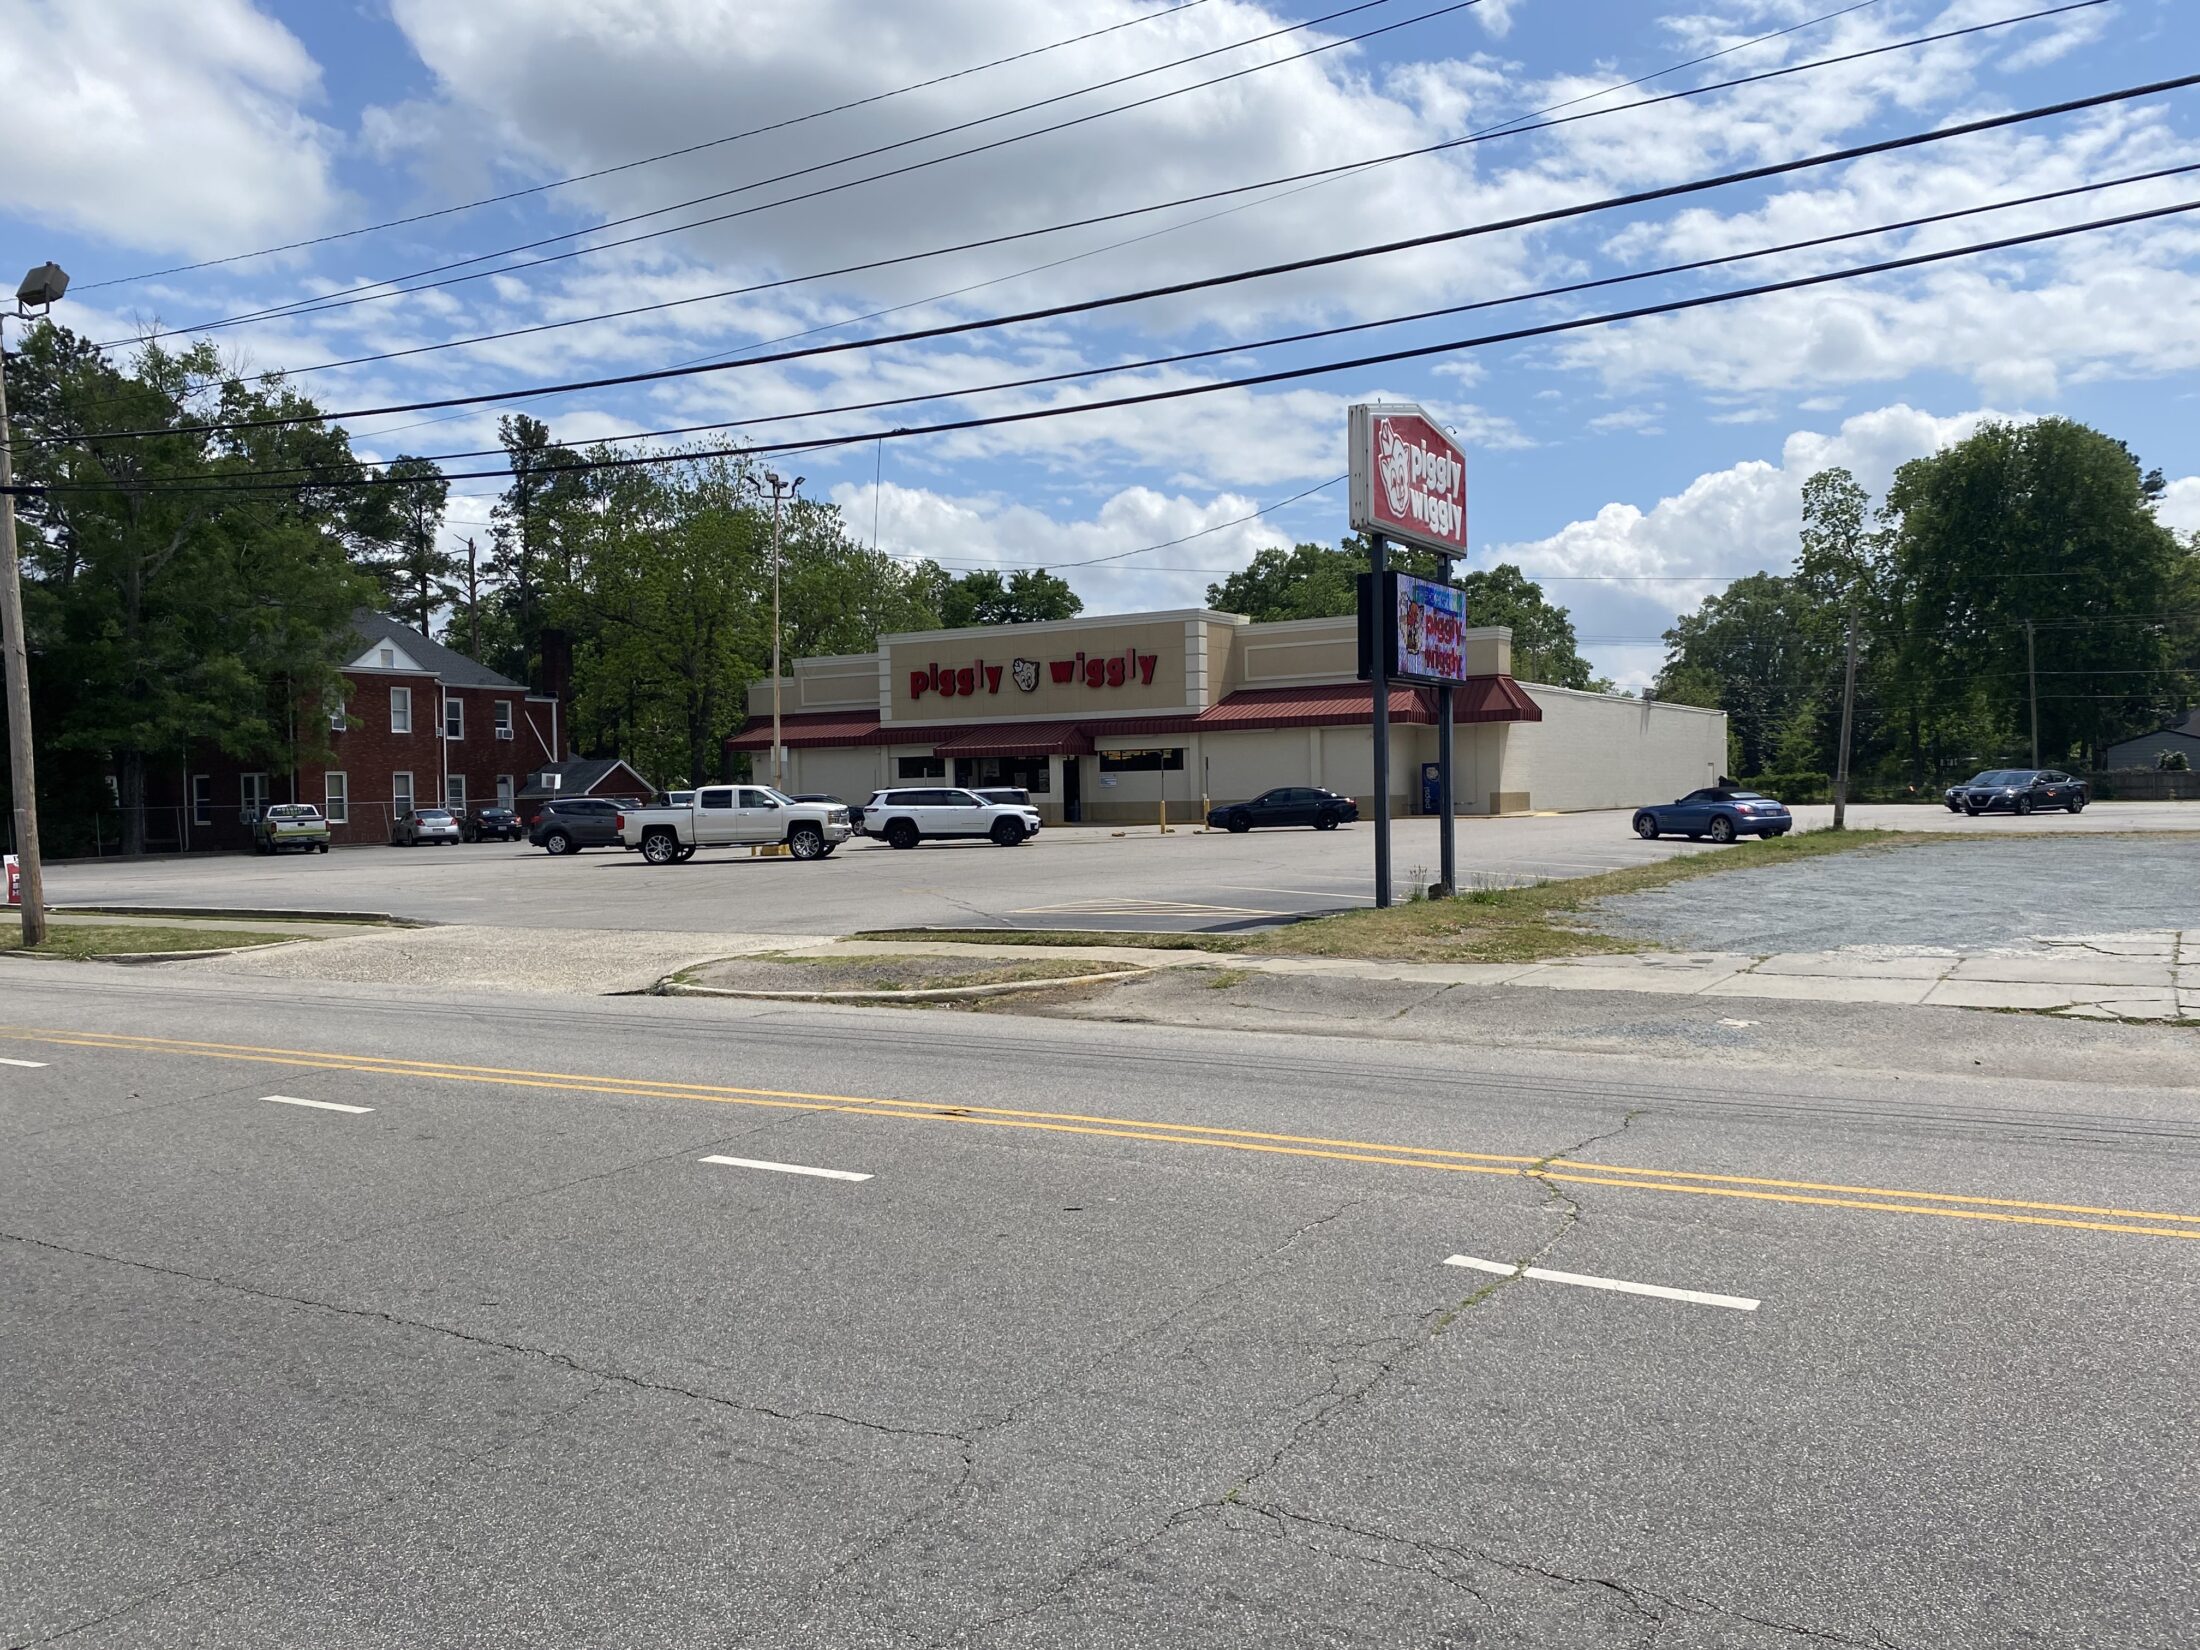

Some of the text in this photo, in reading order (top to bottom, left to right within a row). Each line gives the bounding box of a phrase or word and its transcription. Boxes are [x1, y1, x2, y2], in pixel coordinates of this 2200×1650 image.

[1410, 439, 1462, 498] piggly
[1409, 487, 1462, 541] wiggly
[910, 648, 1157, 699] piggly wiggly
